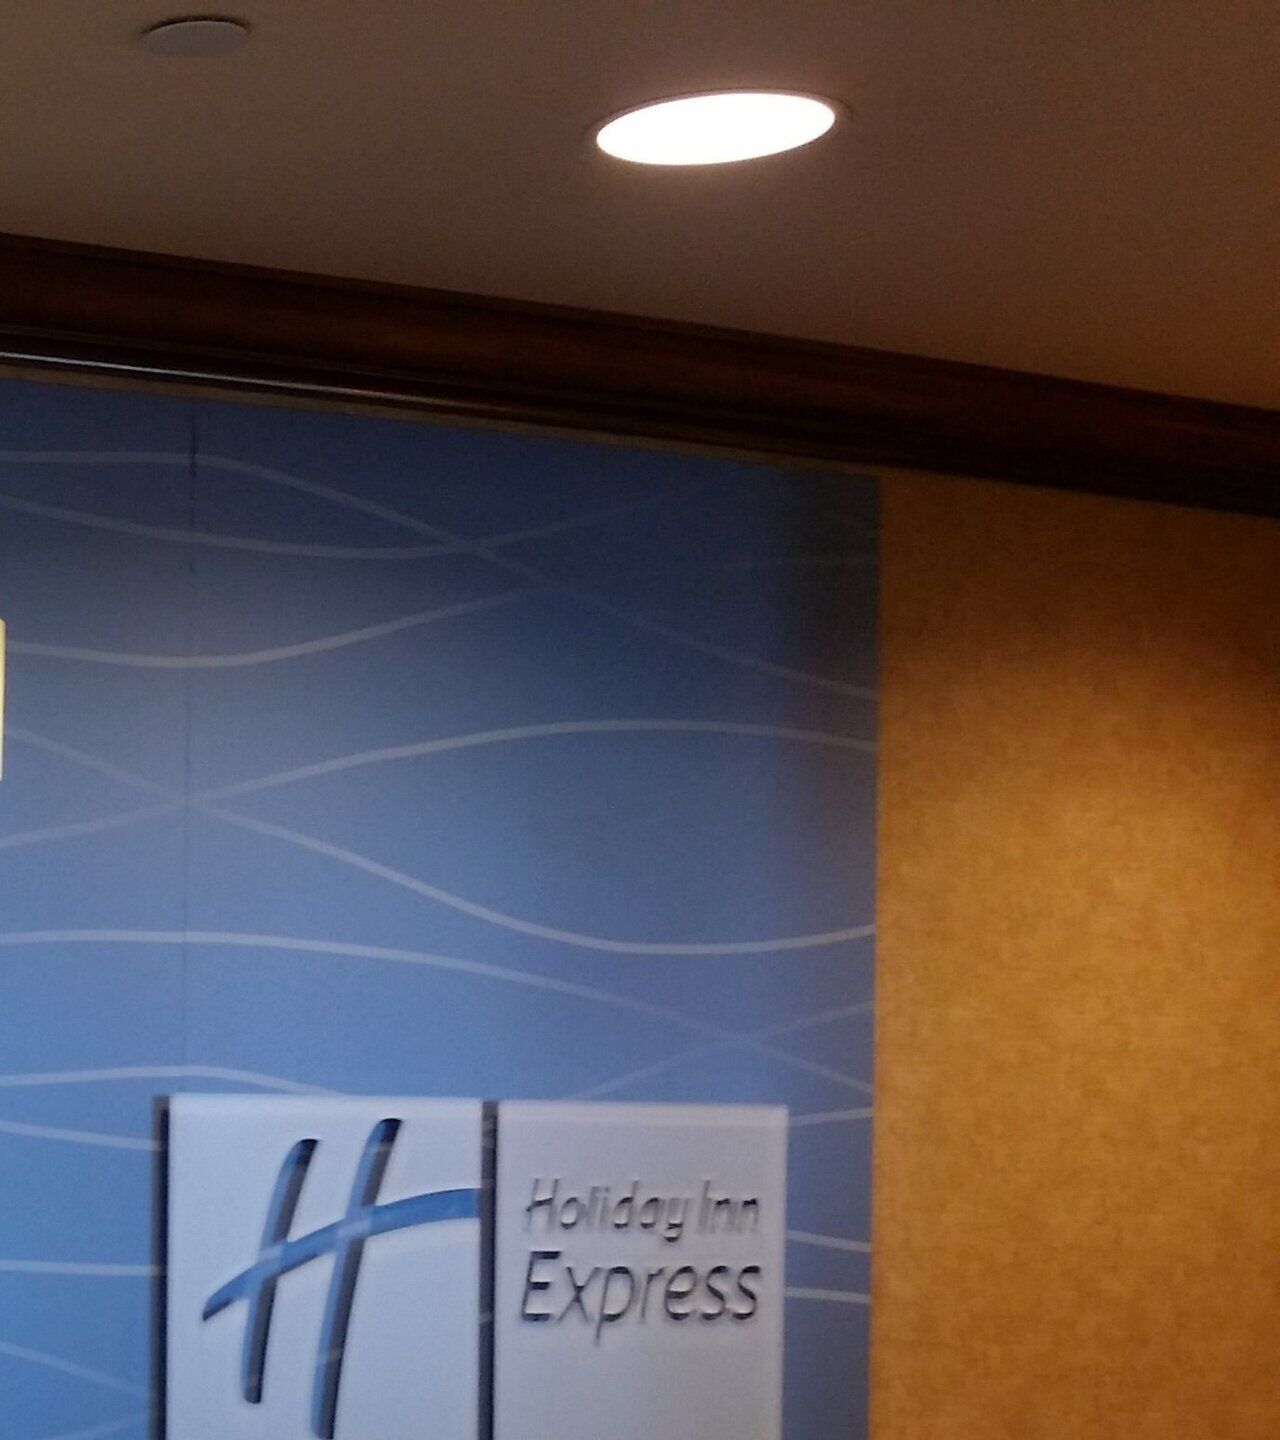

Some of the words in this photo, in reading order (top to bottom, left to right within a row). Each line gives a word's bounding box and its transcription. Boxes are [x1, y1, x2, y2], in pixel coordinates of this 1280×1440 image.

[524, 1178, 690, 1243] Holiday
[696, 1179, 760, 1234] Inn
[520, 1251, 762, 1344] Express
